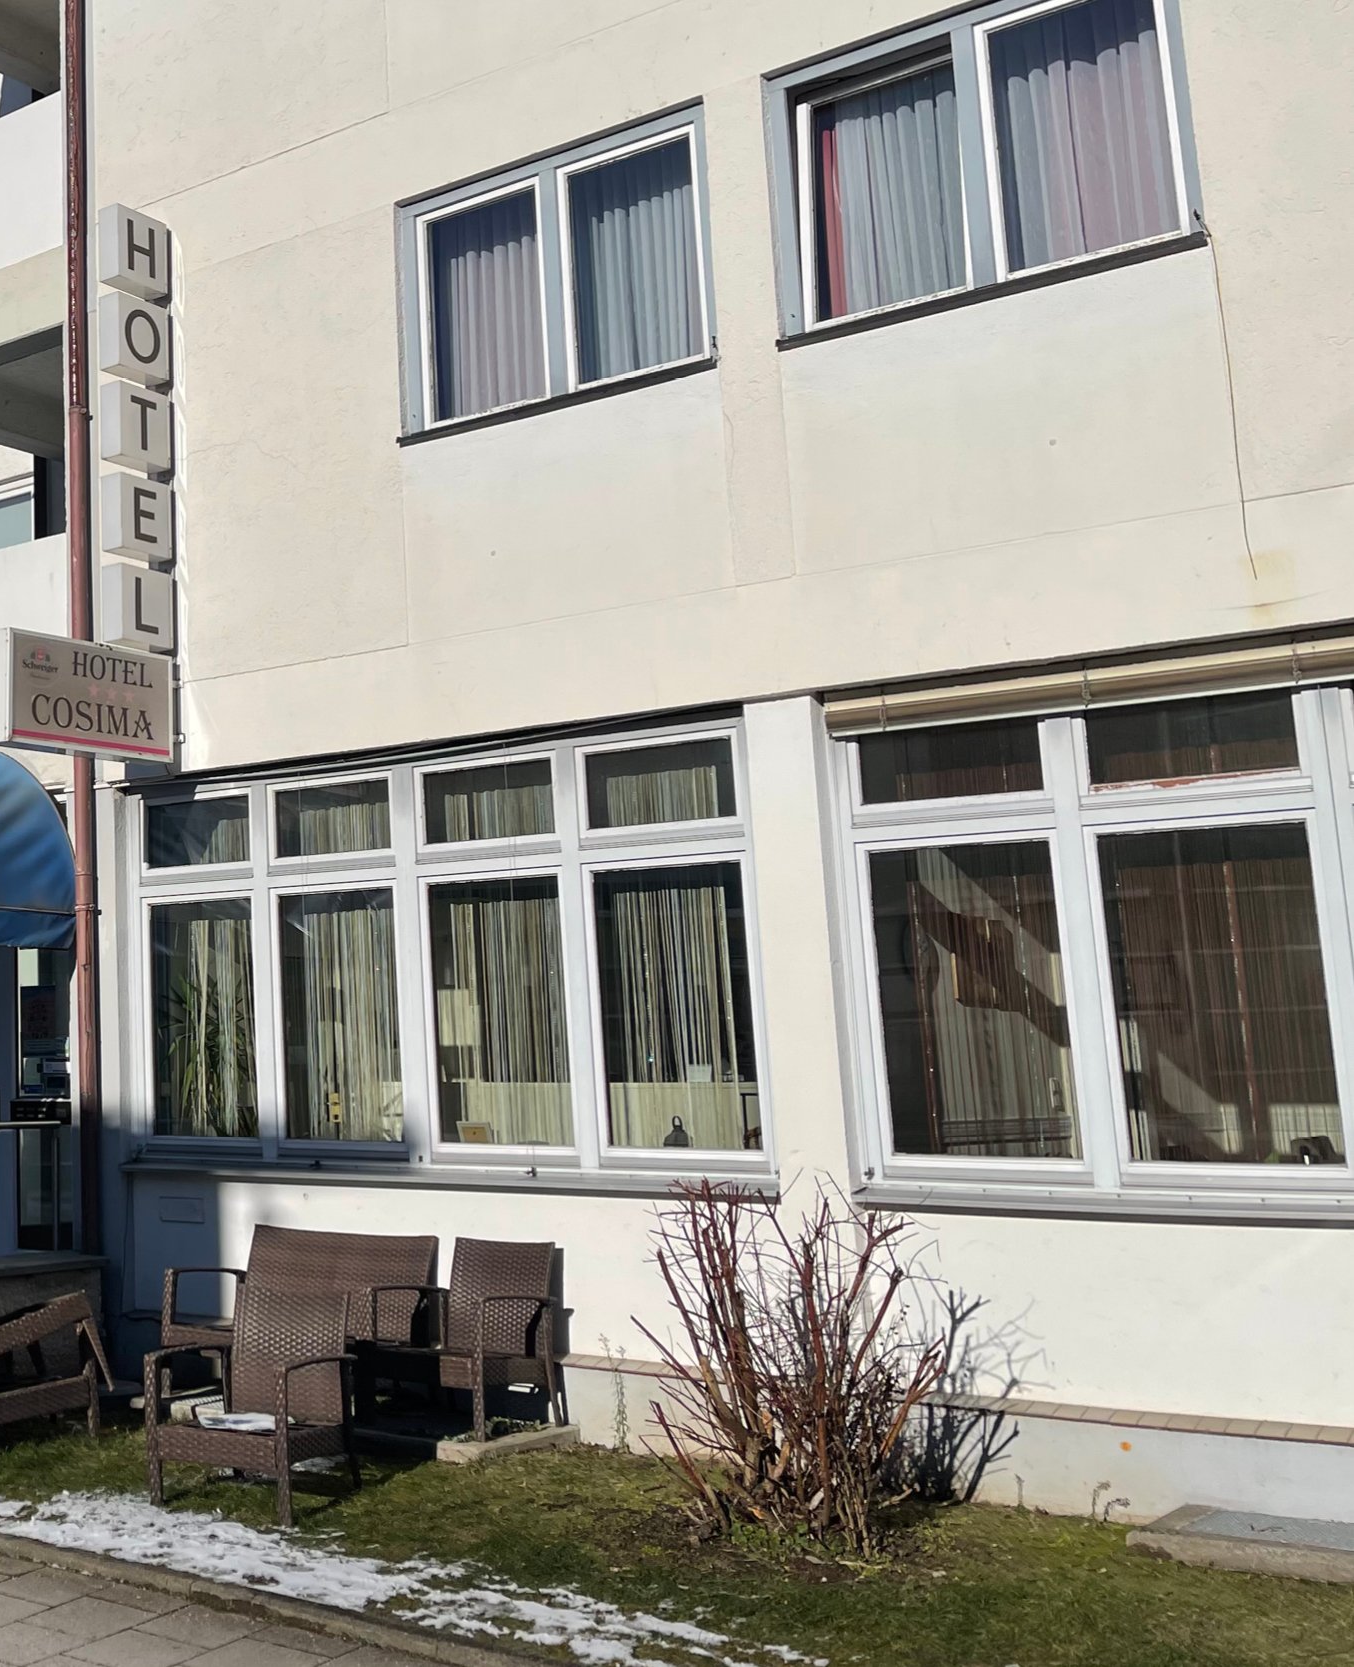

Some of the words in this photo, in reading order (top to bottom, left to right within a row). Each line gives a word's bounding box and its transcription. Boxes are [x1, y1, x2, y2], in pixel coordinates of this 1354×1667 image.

[124, 217, 161, 635] HOTEL
[72, 650, 154, 689] HOTEL
[31, 693, 154, 741] COSIMA
